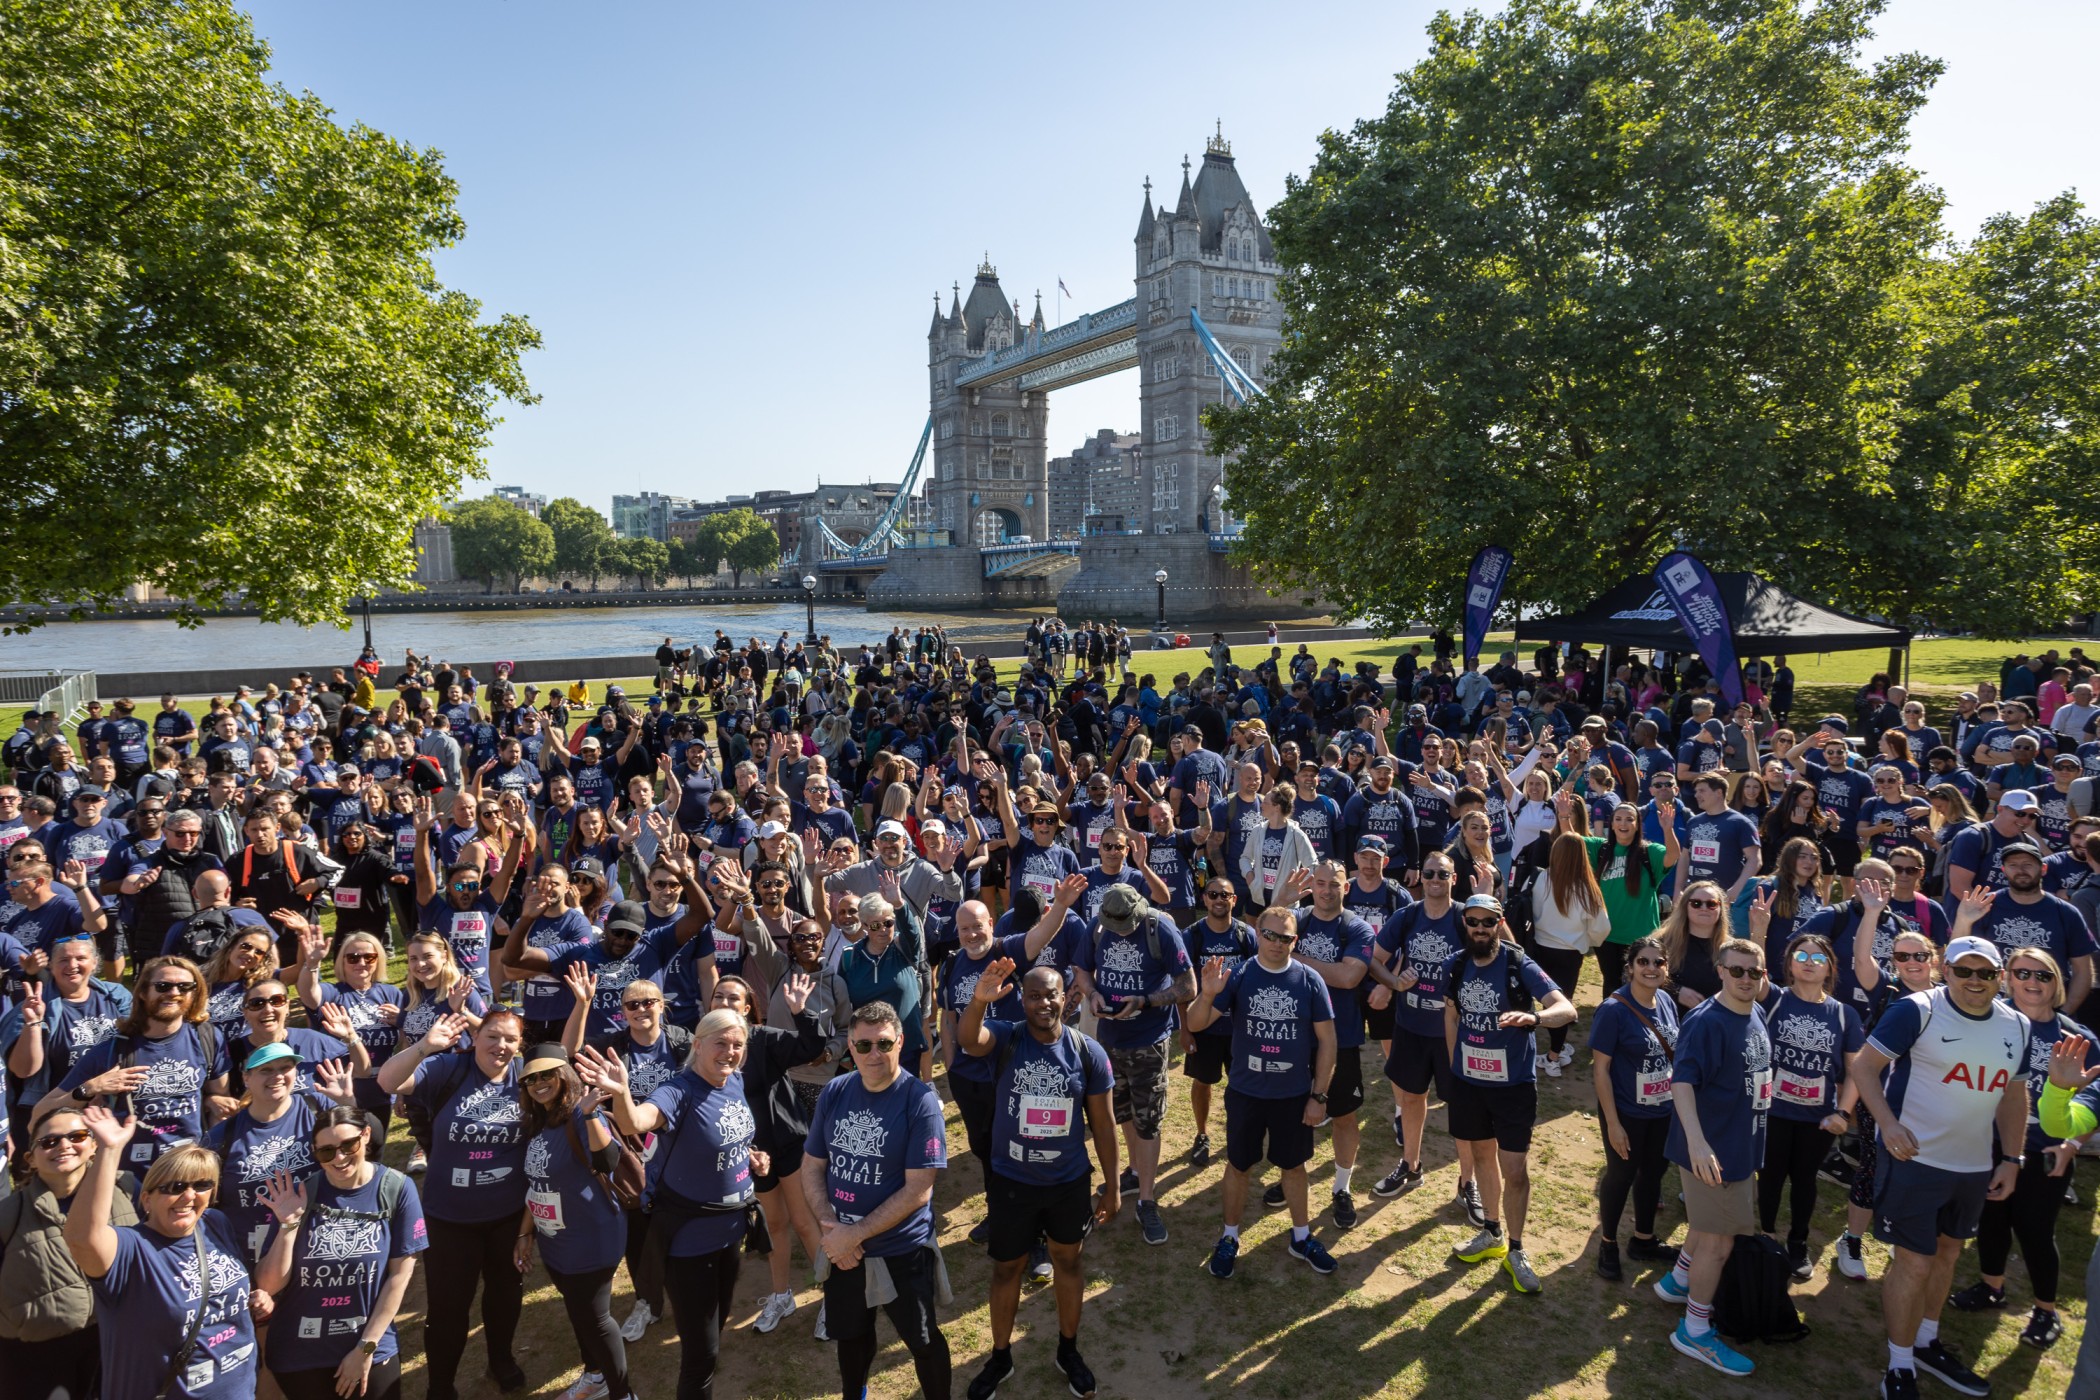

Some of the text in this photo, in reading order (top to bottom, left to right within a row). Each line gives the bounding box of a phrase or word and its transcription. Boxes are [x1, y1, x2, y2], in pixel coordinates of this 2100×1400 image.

[1478, 556, 1490, 577] YOUTH
[1482, 552, 1497, 583] WITHOUT
[1489, 554, 1504, 582] LIMITS
[1673, 572, 1687, 588] DE
[1479, 592, 1488, 602] DE
[1691, 592, 1721, 630] WITHOUT
[1701, 594, 1722, 620] YOUTH
[1686, 603, 1714, 636] LIMITS
[1412, 796, 1440, 807] ROYAL
[1698, 848, 1711, 856] 158
[463, 921, 481, 930] 221
[1409, 960, 1443, 974] OYA
[1101, 971, 1144, 984] ROYAL
[1101, 979, 1144, 990] RAMBLE
[1419, 983, 1435, 992] 2025
[593, 991, 623, 1002] ROY
[593, 1000, 622, 1010] RAM
[1247, 1020, 1297, 1032] ROYAL
[1247, 1028, 1297, 1040] RAMBLE
[1468, 1034, 1485, 1043] 2025
[1261, 1045, 1281, 1053] 2025
[1774, 1044, 1832, 1066] ROYAL
[1474, 1059, 1495, 1071] 185
[1643, 1056, 1667, 1069] ROY
[1774, 1054, 1830, 1072] RAMBLE
[1942, 1062, 2010, 1093] AIA
[1650, 1081, 1670, 1094] 220
[1791, 1086, 1809, 1097] 43
[142, 1104, 197, 1121] AMBLE
[1042, 1111, 1051, 1124] 9
[450, 1122, 523, 1138] ROYAL
[449, 1133, 523, 1144] RAMBLE
[469, 1151, 494, 1160] 2025
[718, 1139, 752, 1162] ROYA
[835, 1188, 855, 1202] 2025
[531, 1203, 550, 1218] 206
[301, 1260, 378, 1279] ROYAL
[301, 1272, 375, 1288] RAMBLE
[321, 1296, 352, 1307] 2025
[208, 1326, 237, 1348] 2025
